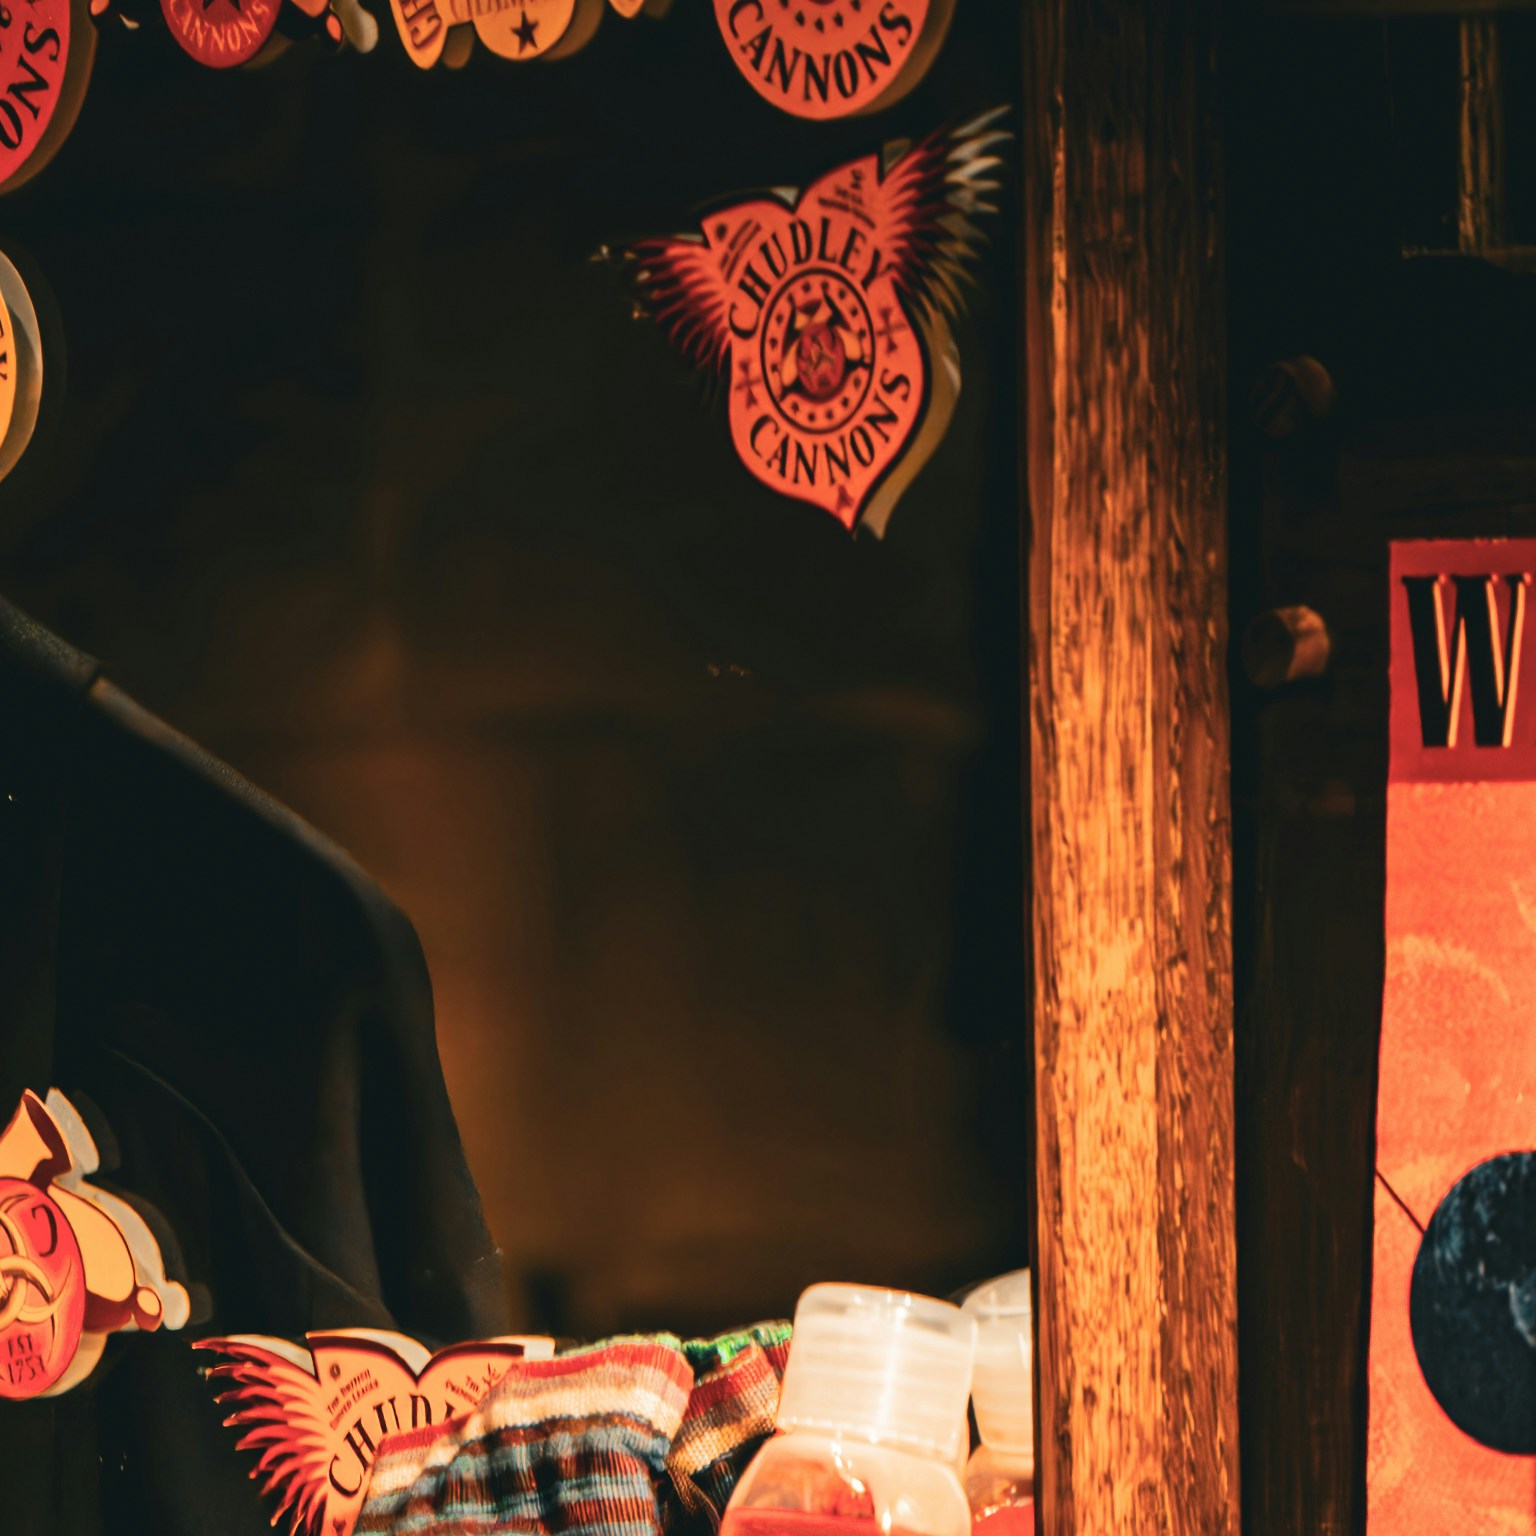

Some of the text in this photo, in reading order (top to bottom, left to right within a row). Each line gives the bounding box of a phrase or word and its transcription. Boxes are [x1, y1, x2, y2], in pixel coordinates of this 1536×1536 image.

[729, 0, 912, 104] CANNONS
[728, 216, 888, 341] CHUDLEY
[749, 367, 911, 487] CANNONS
